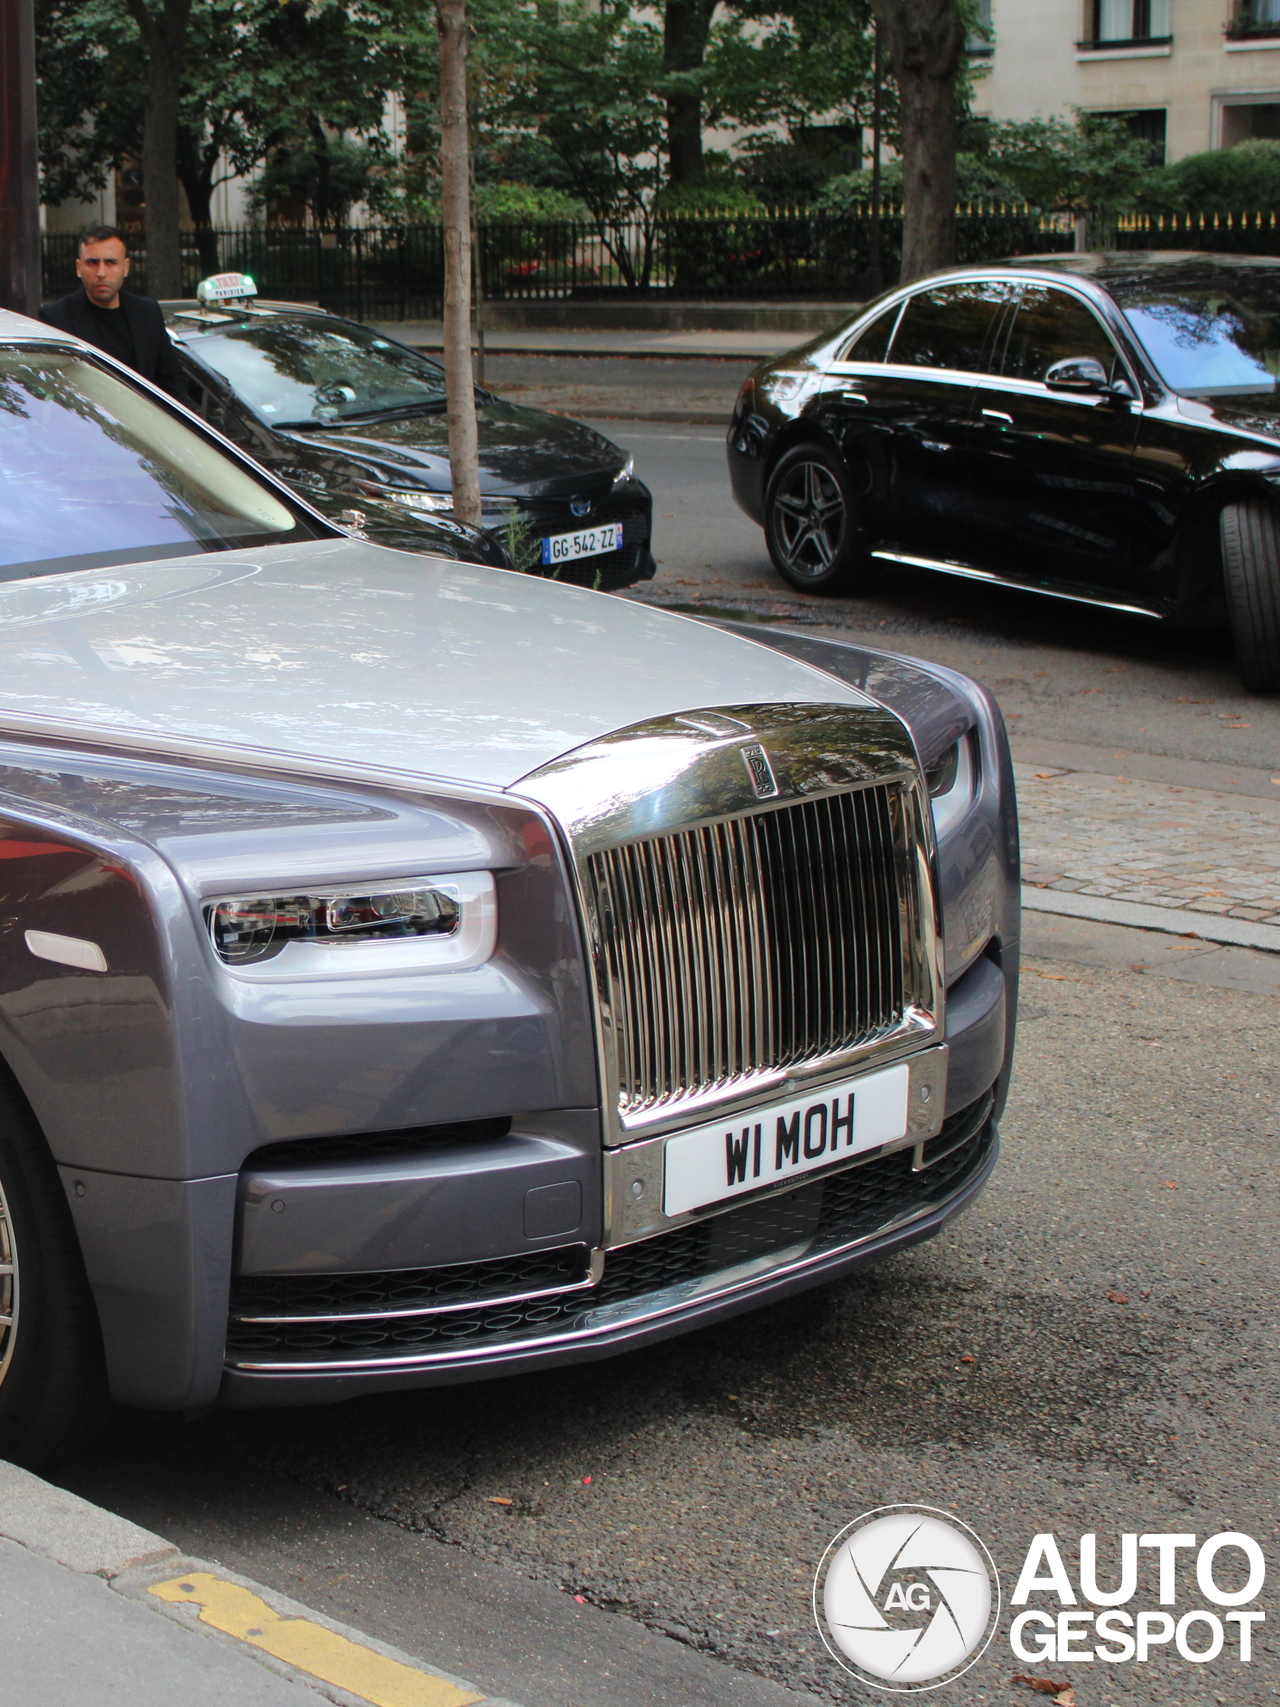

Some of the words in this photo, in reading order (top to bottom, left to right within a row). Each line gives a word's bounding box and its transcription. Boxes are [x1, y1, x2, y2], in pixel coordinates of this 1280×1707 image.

[215, 288, 245, 297] PARISIEN
[216, 276, 240, 289] TAXI
[552, 528, 615, 559] GG-542-ZZ
[775, 1092, 856, 1171] MOH
